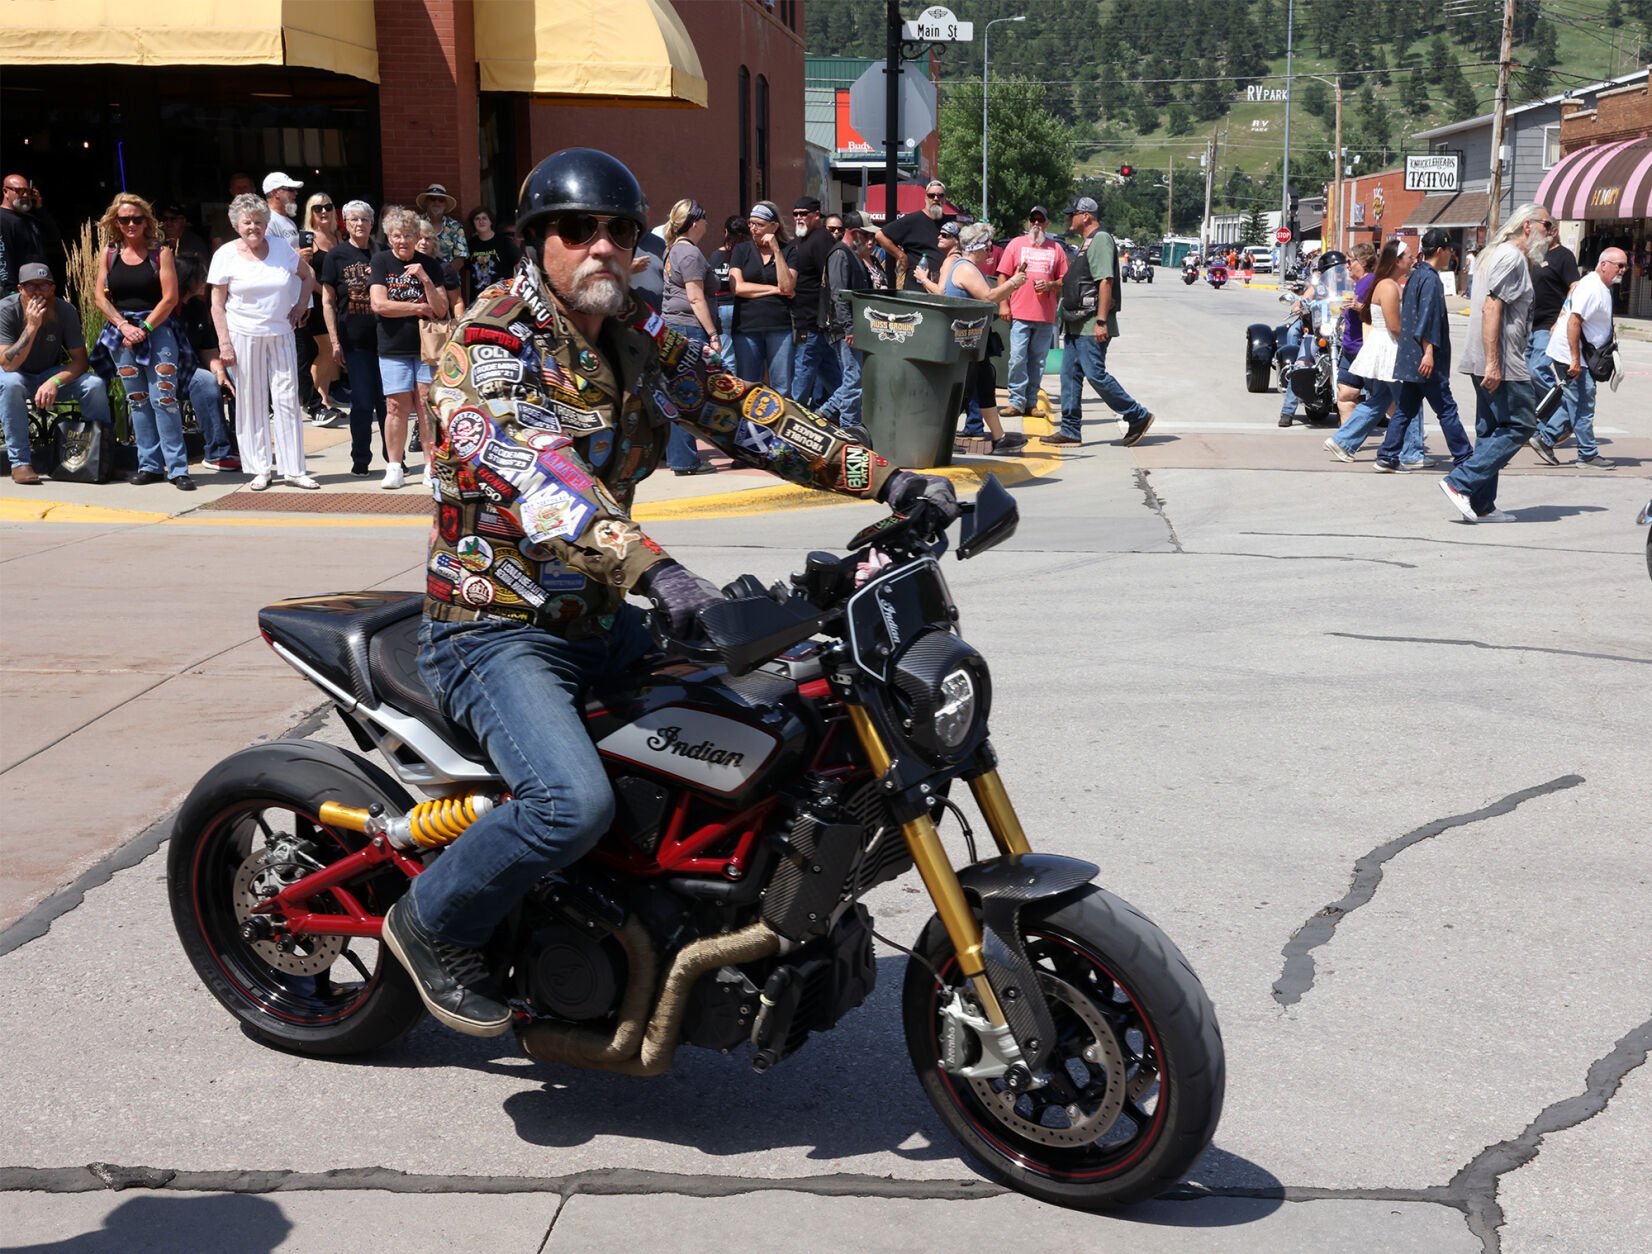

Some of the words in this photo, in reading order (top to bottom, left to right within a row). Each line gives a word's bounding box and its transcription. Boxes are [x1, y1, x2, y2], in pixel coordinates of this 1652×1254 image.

[917, 24, 940, 37] Main
[947, 24, 958, 38] St
[1247, 85, 1263, 101] RV
[1263, 89, 1288, 101] PARK
[1408, 171, 1454, 188] TATTOO
[1276, 230, 1291, 239] STOP
[519, 280, 551, 321] SNAFU
[784, 428, 824, 452] TROUBLE
[792, 423, 825, 443] MAKER
[478, 467, 513, 497] HONDA
[478, 482, 502, 502] 450
[881, 599, 901, 643] Indian
[646, 726, 745, 768] Indian
[946, 1026, 956, 1064] brembo
